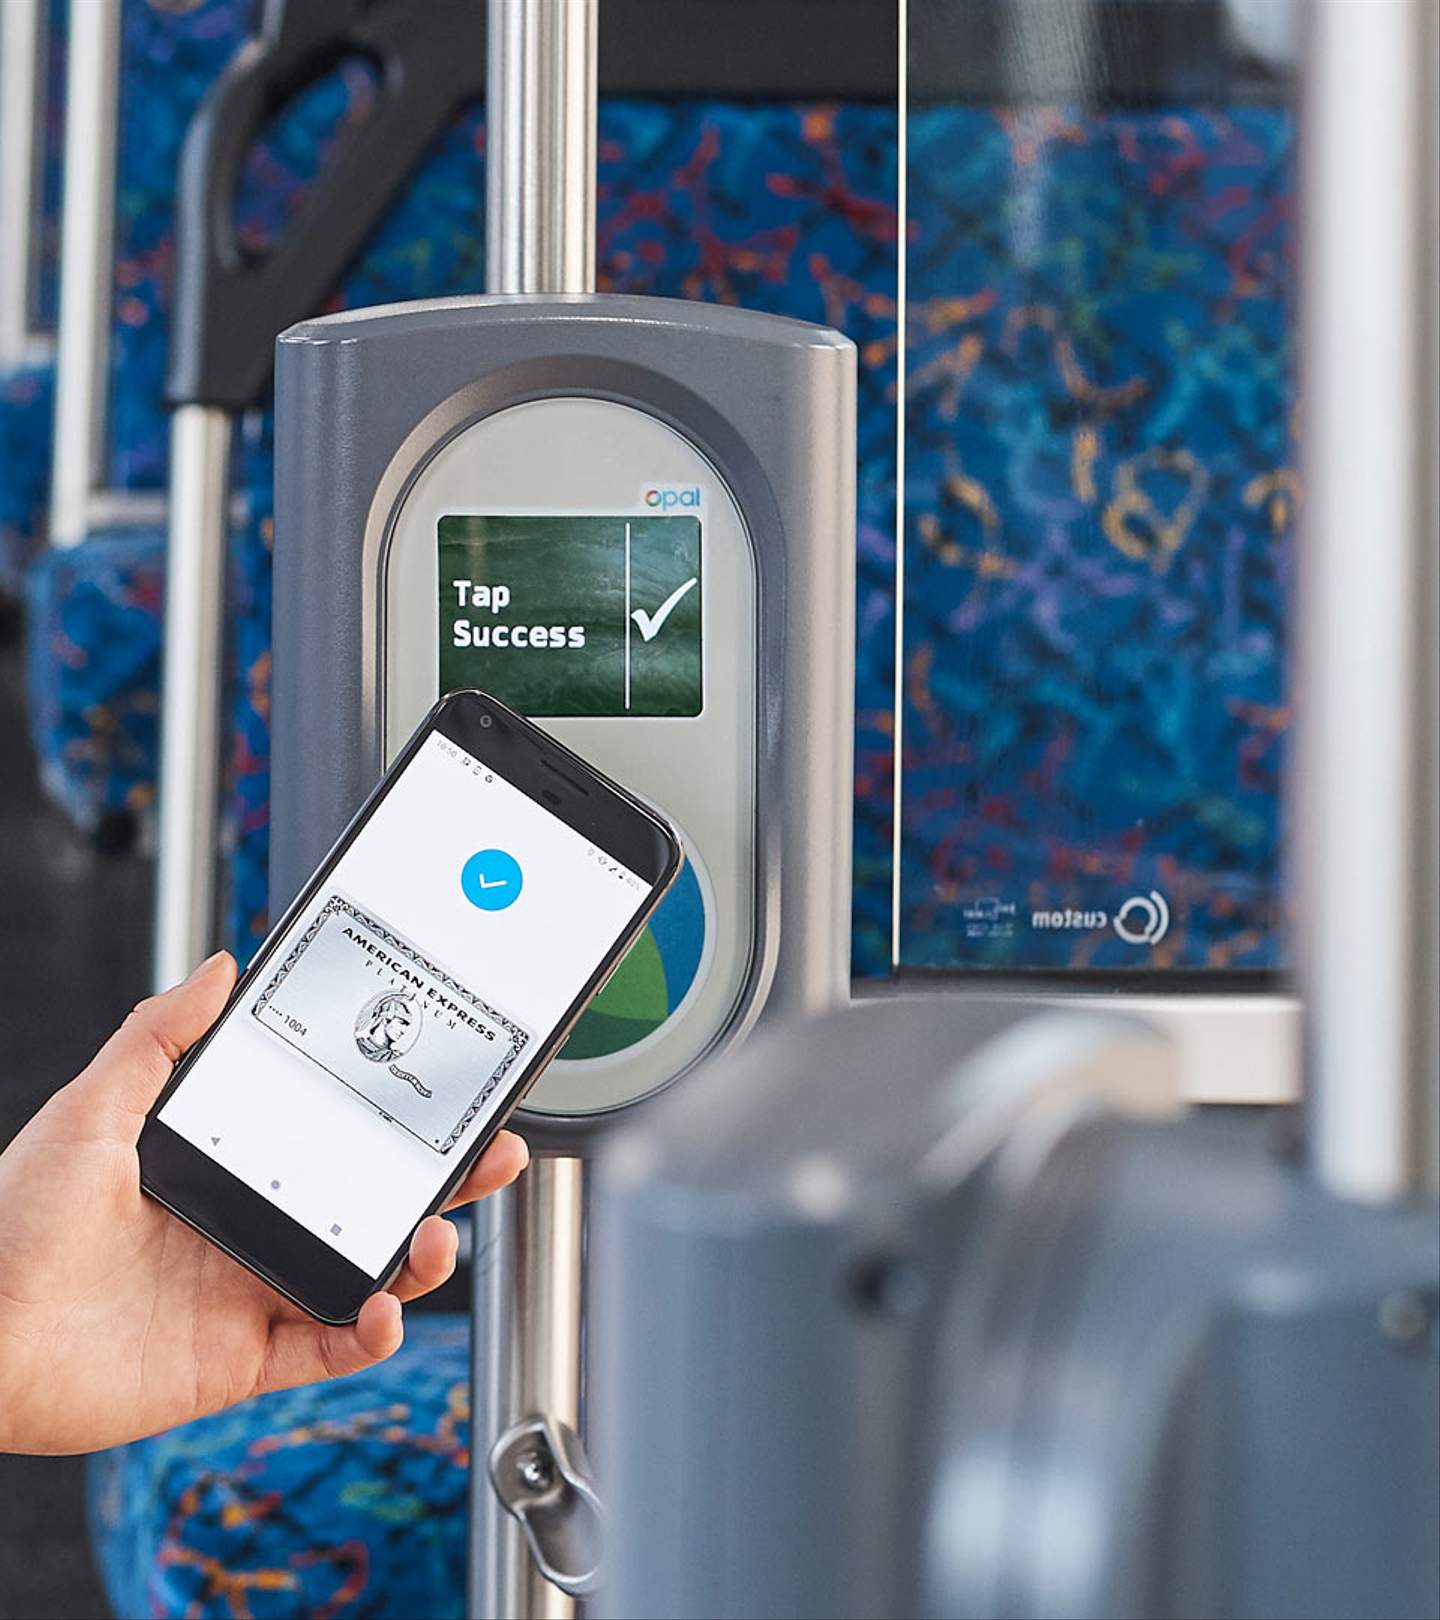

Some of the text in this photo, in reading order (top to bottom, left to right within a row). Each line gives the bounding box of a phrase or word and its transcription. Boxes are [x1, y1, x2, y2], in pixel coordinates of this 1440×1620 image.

[645, 488, 700, 511] opal
[453, 580, 510, 613] Tap
[453, 620, 585, 648] Success
[342, 927, 496, 1042] AMERICAN EXPRESS
[365, 959, 457, 1030] PLATINUM
[284, 1014, 308, 1036] 1004
